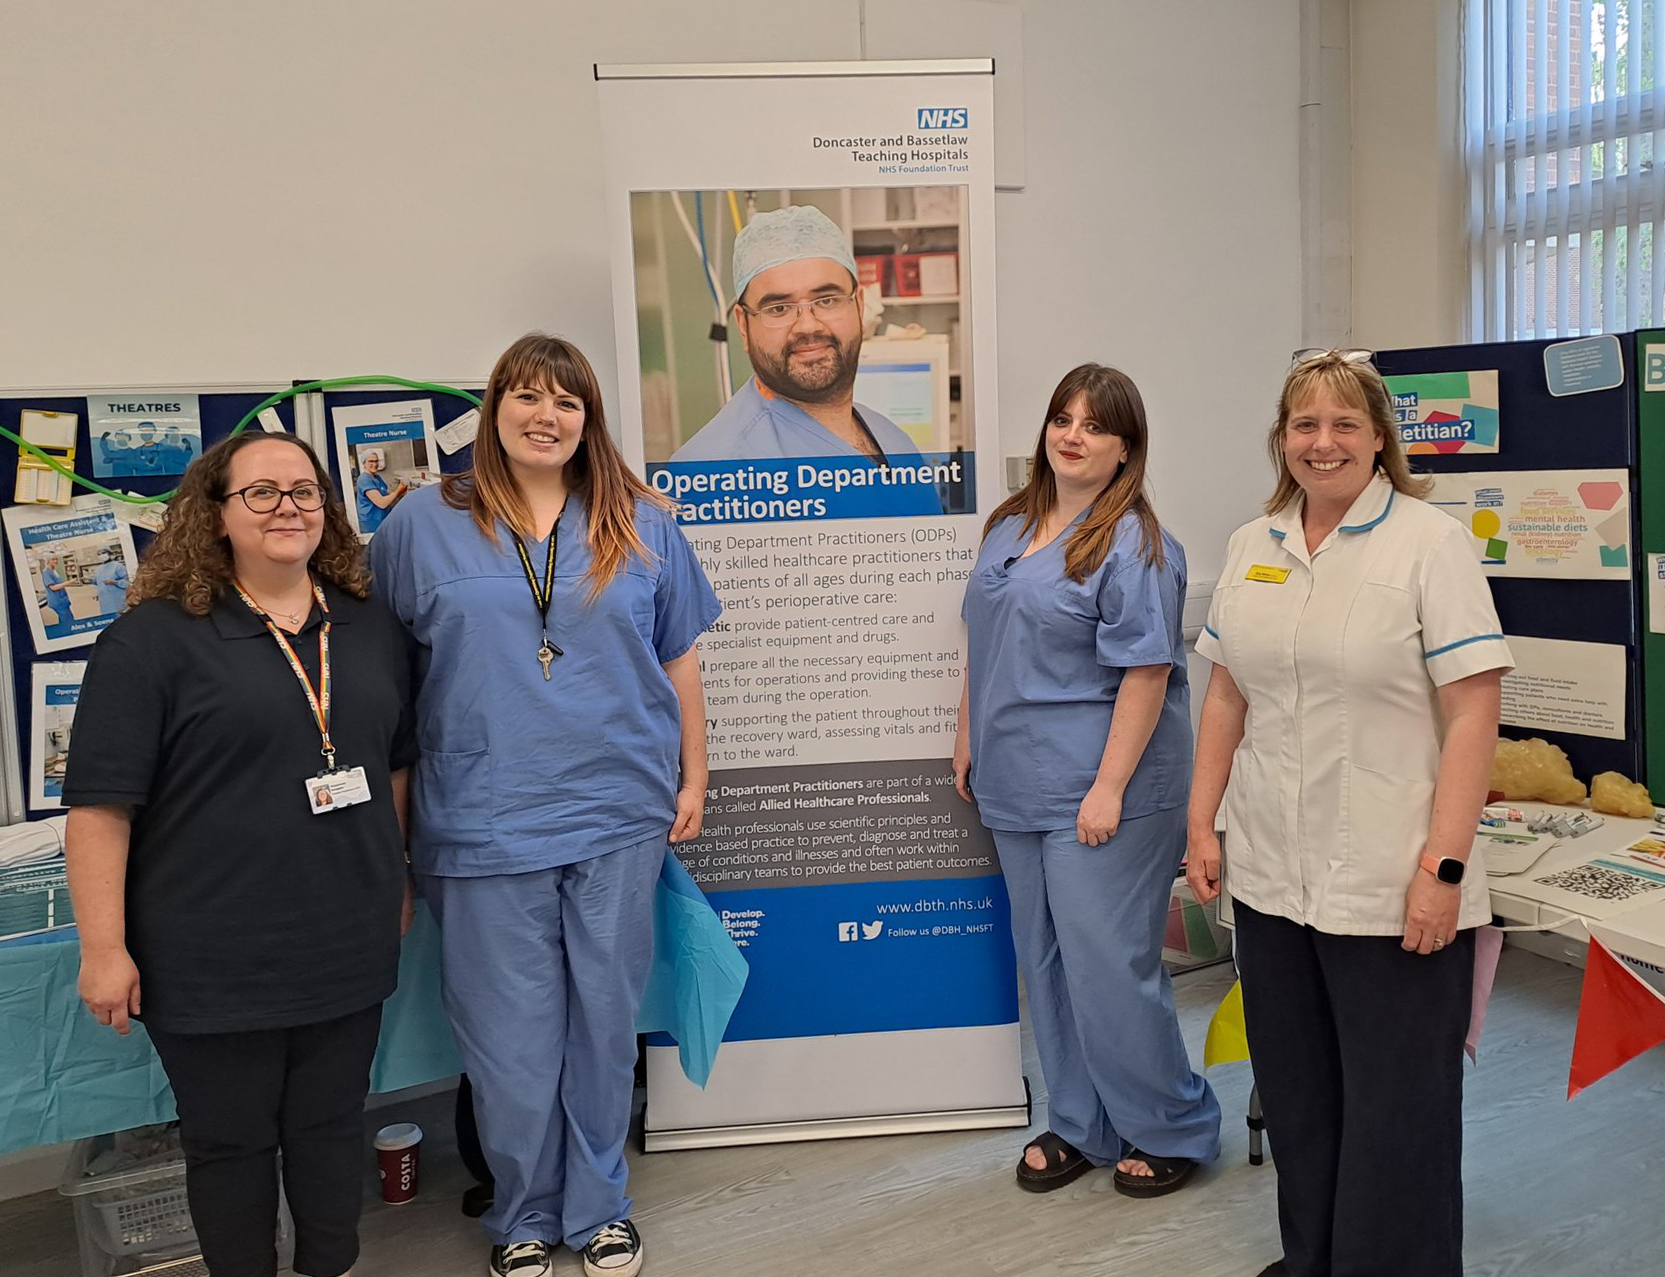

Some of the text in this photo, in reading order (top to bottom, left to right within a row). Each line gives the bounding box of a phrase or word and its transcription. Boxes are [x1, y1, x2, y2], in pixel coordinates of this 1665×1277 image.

[919, 108, 966, 129] NHS
[813, 134, 969, 148] Doncaster and Bassetlaw
[852, 148, 969, 163] Teaching Hospitals
[878, 164, 969, 173] NHS Foundation Trust
[1648, 353, 1665, 385] B
[107, 403, 181, 413] THEATRES
[1392, 394, 1416, 407] hat
[1398, 421, 1472, 441] ietitian?
[652, 461, 961, 498] Operating Department
[1508, 523, 1588, 532] sustainable diets
[1525, 515, 1554, 523] mental
[1557, 515, 1585, 523] health
[688, 527, 957, 553] ating Department Practitioners (ODPs)
[1517, 539, 1578, 547] gastroenterology
[700, 548, 973, 573] hly skilled healthcare practitioners that
[714, 576, 770, 594] patients
[775, 574, 790, 588] of
[794, 573, 808, 586] all
[814, 575, 845, 588] ages
[850, 571, 894, 586] during
[899, 569, 931, 582] each
[766, 593, 859, 610] perioperative
[864, 593, 897, 604] care:
[735, 619, 780, 634] provide
[785, 614, 878, 630] patient-centred
[882, 615, 908, 625] care
[912, 612, 934, 623] and
[707, 636, 762, 652] specialist
[766, 634, 832, 648] equipment
[836, 632, 858, 643] and
[863, 631, 899, 644] drugs.
[710, 660, 758, 674] prepare
[762, 657, 775, 669] all
[779, 656, 799, 668] the
[803, 656, 863, 667] necessary
[867, 651, 933, 665] equipment
[936, 649, 959, 661] and
[734, 675, 752, 688] for
[755, 673, 820, 687] operations
[824, 670, 846, 682] and
[851, 668, 907, 683] providing
[911, 667, 944, 679] these
[948, 668, 960, 678] to
[707, 687, 872, 706] team during the operation.
[721, 713, 787, 727] supporting
[791, 711, 811, 722] the
[816, 709, 858, 724] patient
[862, 706, 930, 720] throughout
[706, 721, 958, 745] the recovery ward, assessing vitals and fit
[724, 751, 736, 760] to
[741, 747, 760, 759] the
[765, 745, 799, 757] ward.
[721, 783, 790, 798] Department
[793, 779, 863, 792] Practitioners
[866, 778, 883, 788] are
[887, 777, 908, 789] part
[911, 775, 923, 786] of
[925, 777, 931, 785] a
[726, 802, 756, 813] called
[759, 799, 791, 810] Allied
[794, 794, 854, 809] Healthcare
[857, 792, 932, 805] Professionals.
[735, 820, 804, 837] professionals
[807, 821, 826, 830] use
[829, 815, 875, 829] scientific
[878, 814, 928, 828] principles
[931, 812, 951, 824] and
[671, 828, 968, 854] vidence based practice to prevent, diagnose and treat a
[699, 856, 710, 867] of
[712, 853, 768, 866] conditions
[772, 851, 792, 862] and
[795, 849, 838, 861] illnesses
[842, 846, 861, 857] and
[864, 845, 893, 856] often
[896, 843, 924, 855] work
[926, 842, 959, 853] within
[693, 856, 992, 884] disciplinary teams to provide the best patient outcomes.
[722, 909, 765, 919] Develop.
[877, 896, 993, 914] www.dbth.nhs.uk
[722, 920, 760, 928] Belong.
[888, 928, 917, 937] Follow
[932, 923, 994, 936] @DBH_NHSFT
[401, 1153, 411, 1190] COSTA
